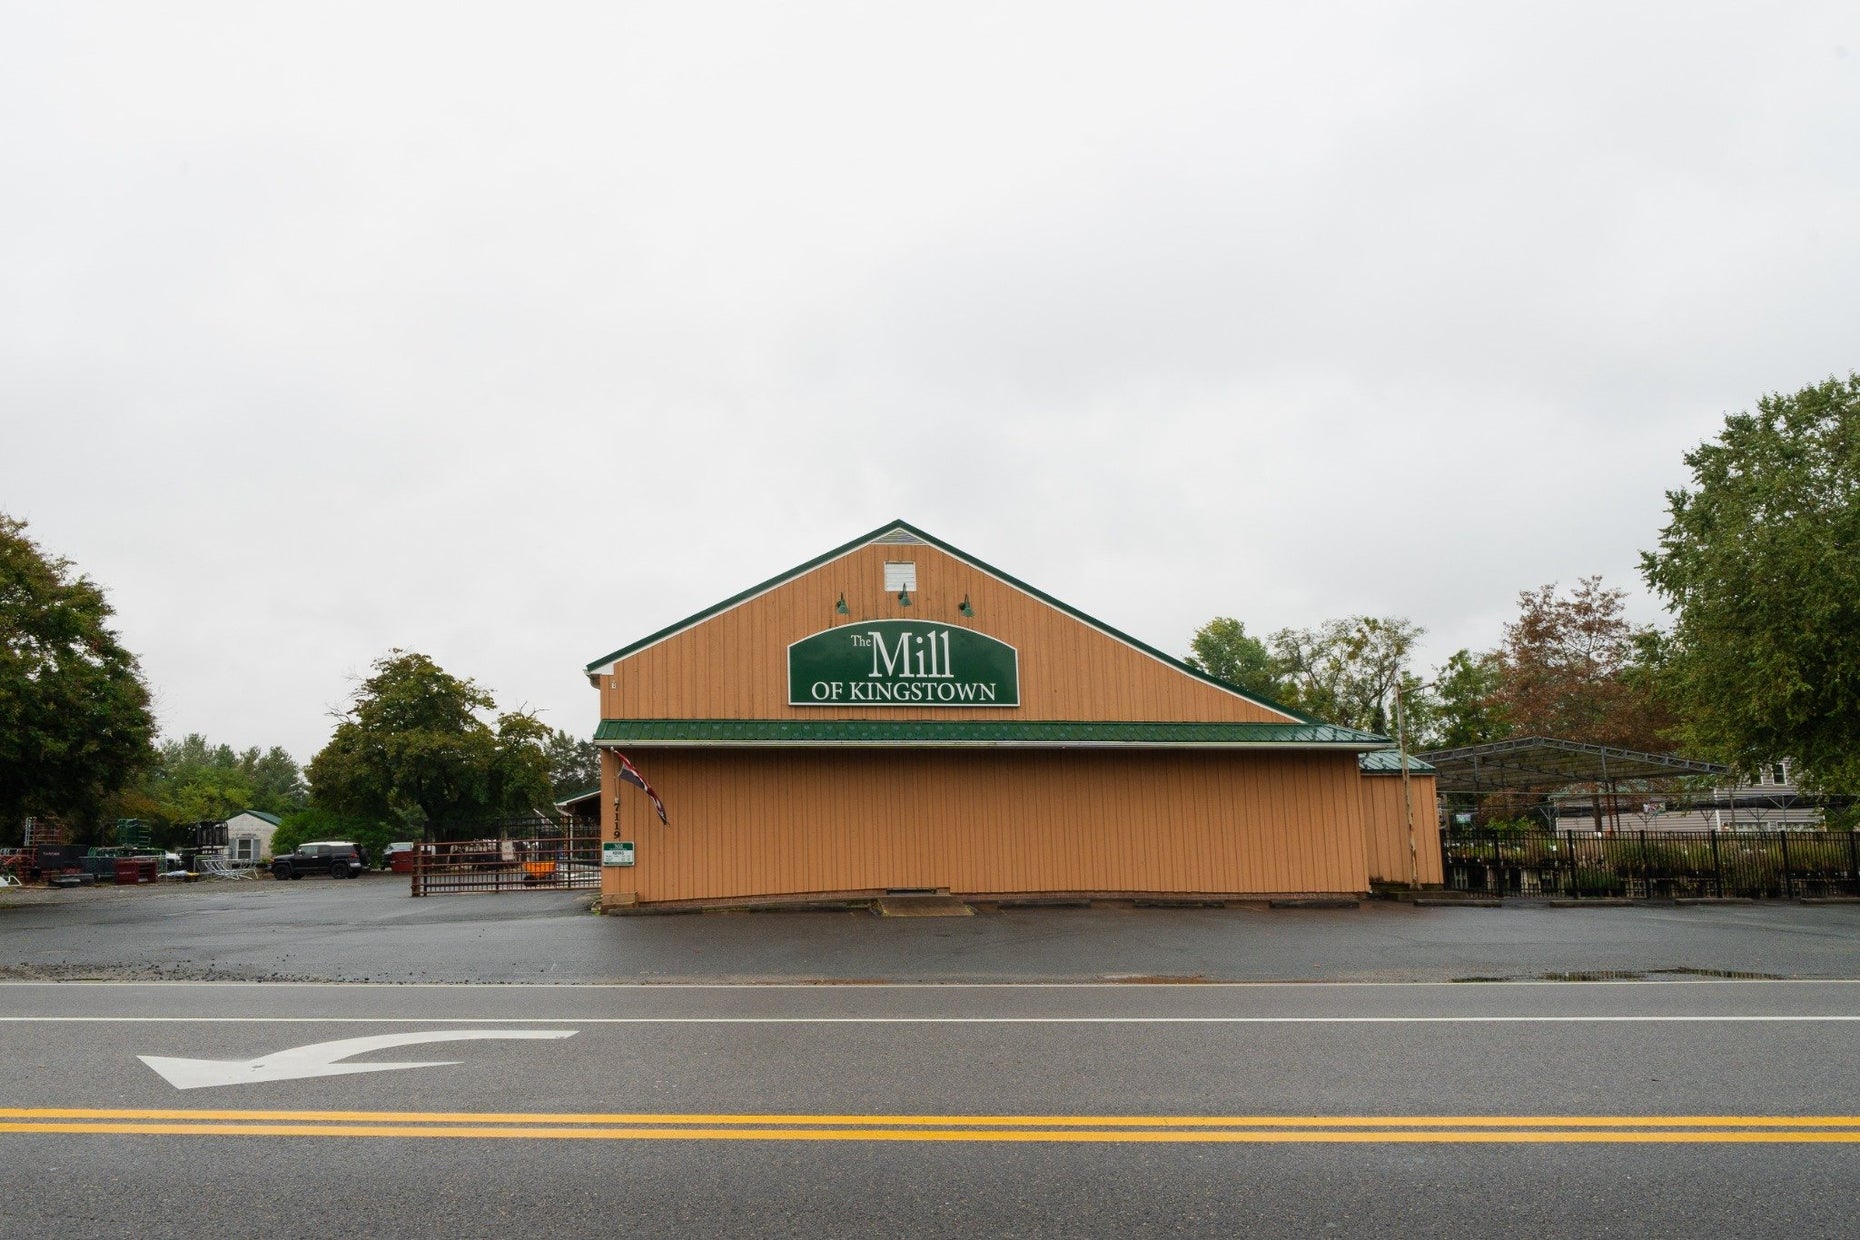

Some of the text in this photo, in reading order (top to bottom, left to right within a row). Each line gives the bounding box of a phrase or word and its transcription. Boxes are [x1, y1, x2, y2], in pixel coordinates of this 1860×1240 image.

[851, 630, 954, 678] The Mill
[811, 681, 997, 702] OF KINGSTOWN
[613, 803, 621, 839] 7119
